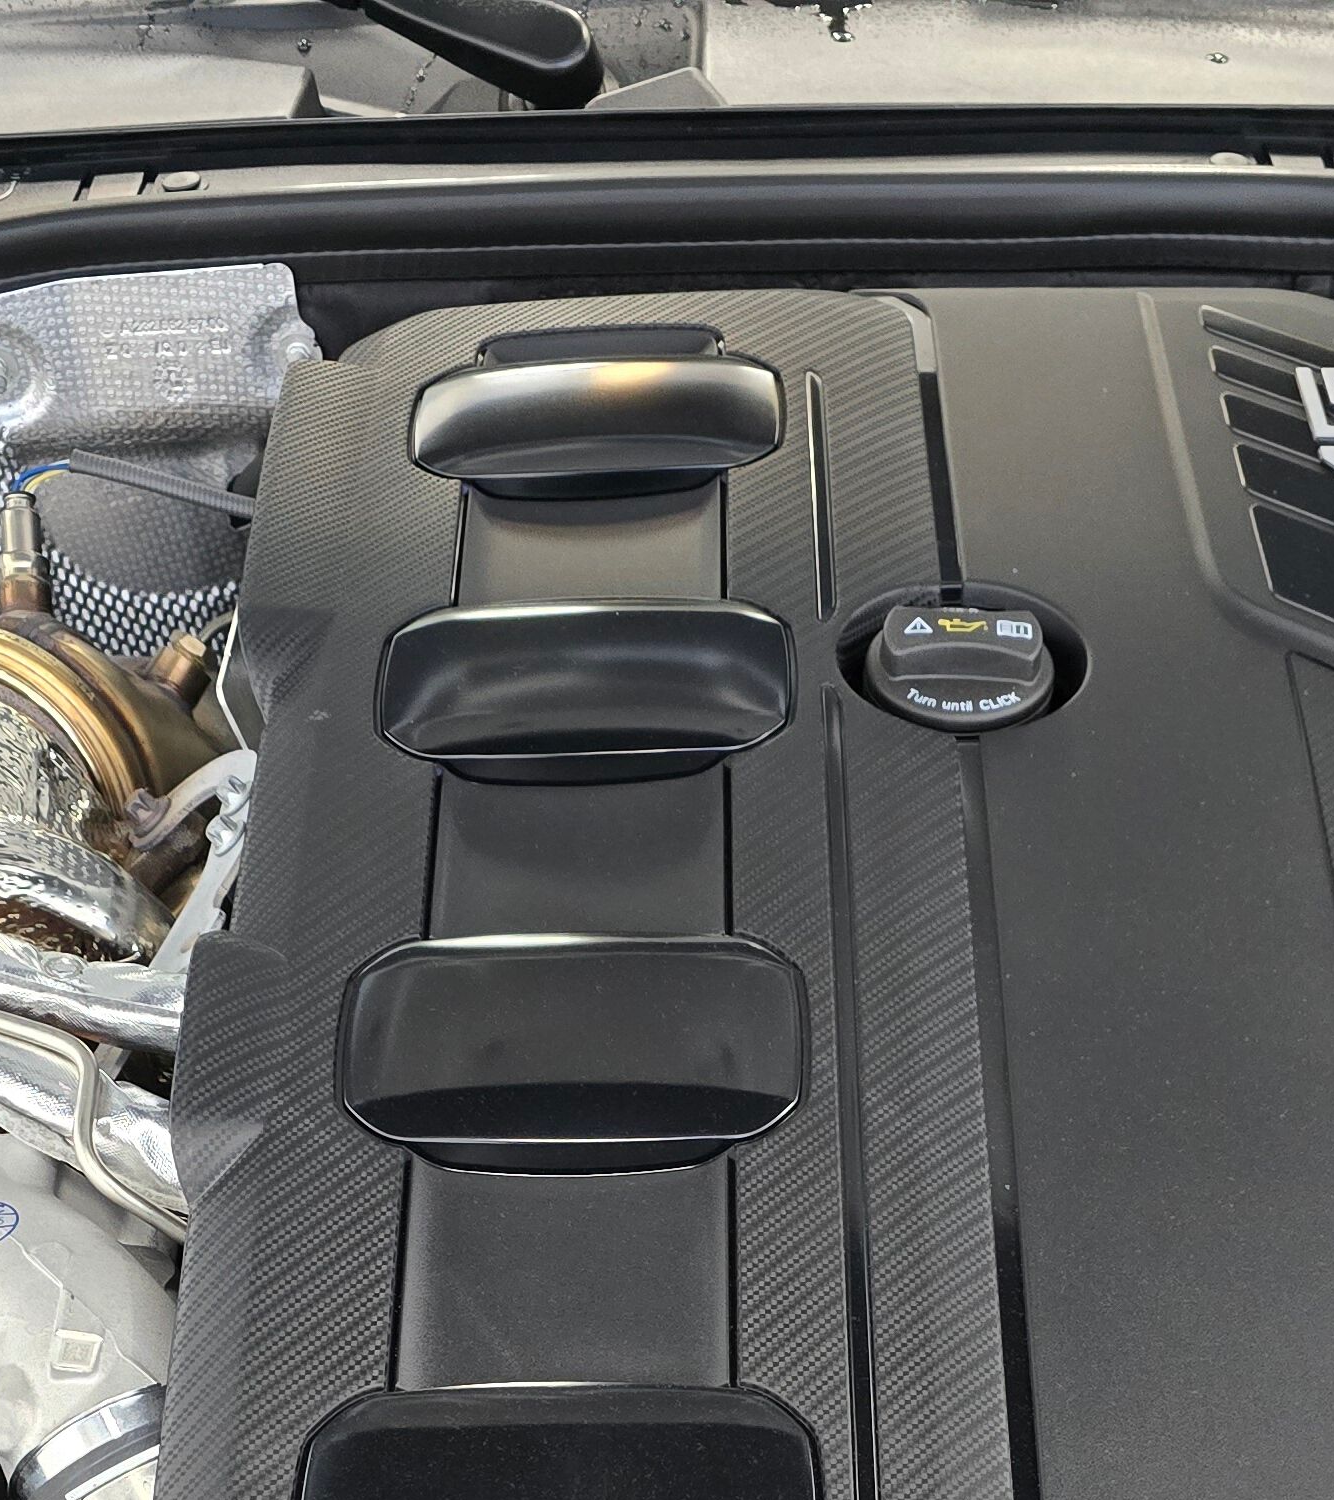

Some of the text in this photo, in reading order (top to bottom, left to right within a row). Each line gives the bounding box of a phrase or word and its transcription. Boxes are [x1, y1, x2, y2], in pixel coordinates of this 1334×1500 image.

[906, 687, 1021, 712] Turn until CLICK
